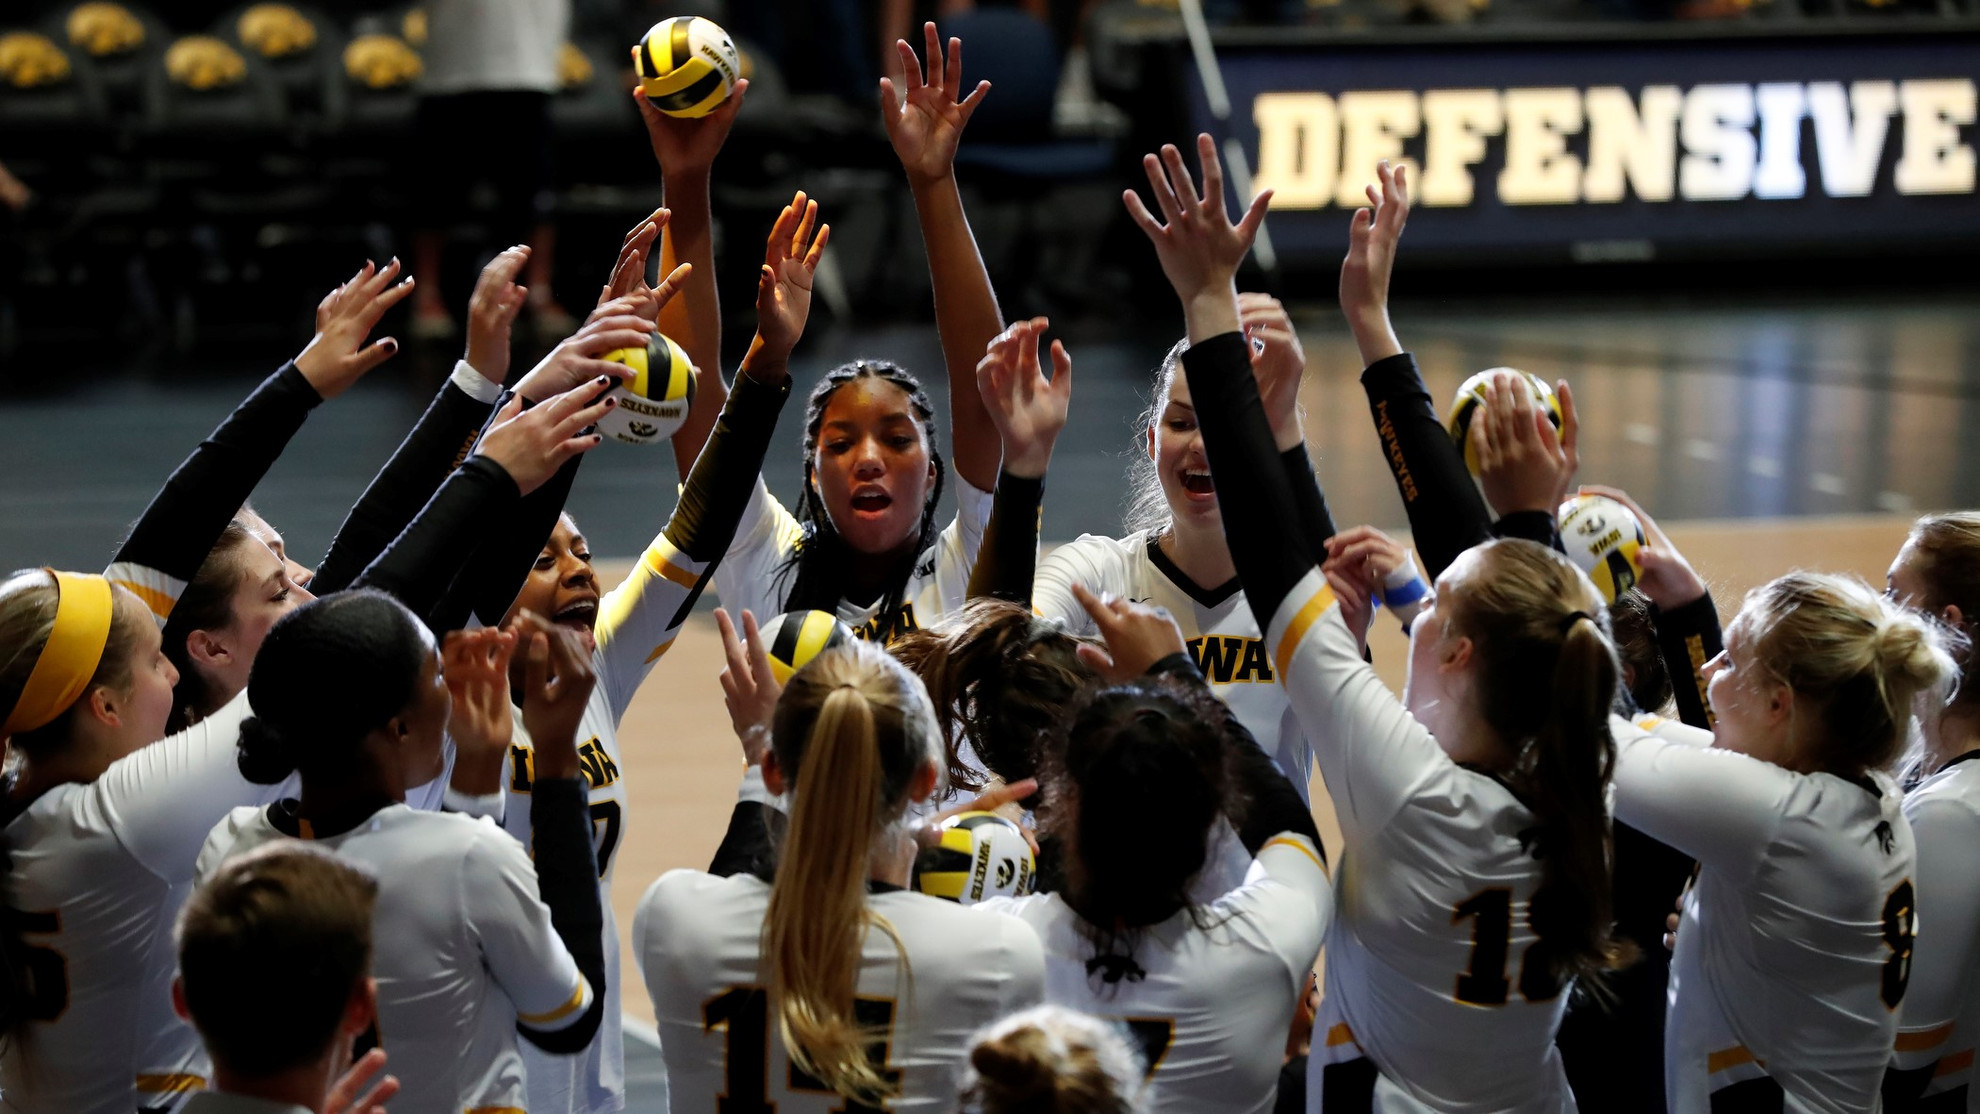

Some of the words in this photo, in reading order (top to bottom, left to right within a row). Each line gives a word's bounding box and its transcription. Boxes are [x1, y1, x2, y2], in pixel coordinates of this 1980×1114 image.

[1252, 79, 1977, 211] DEFENSIVE
[1184, 633, 1276, 685] WA
[509, 734, 620, 795] IWA
[1880, 876, 1914, 1014] 8
